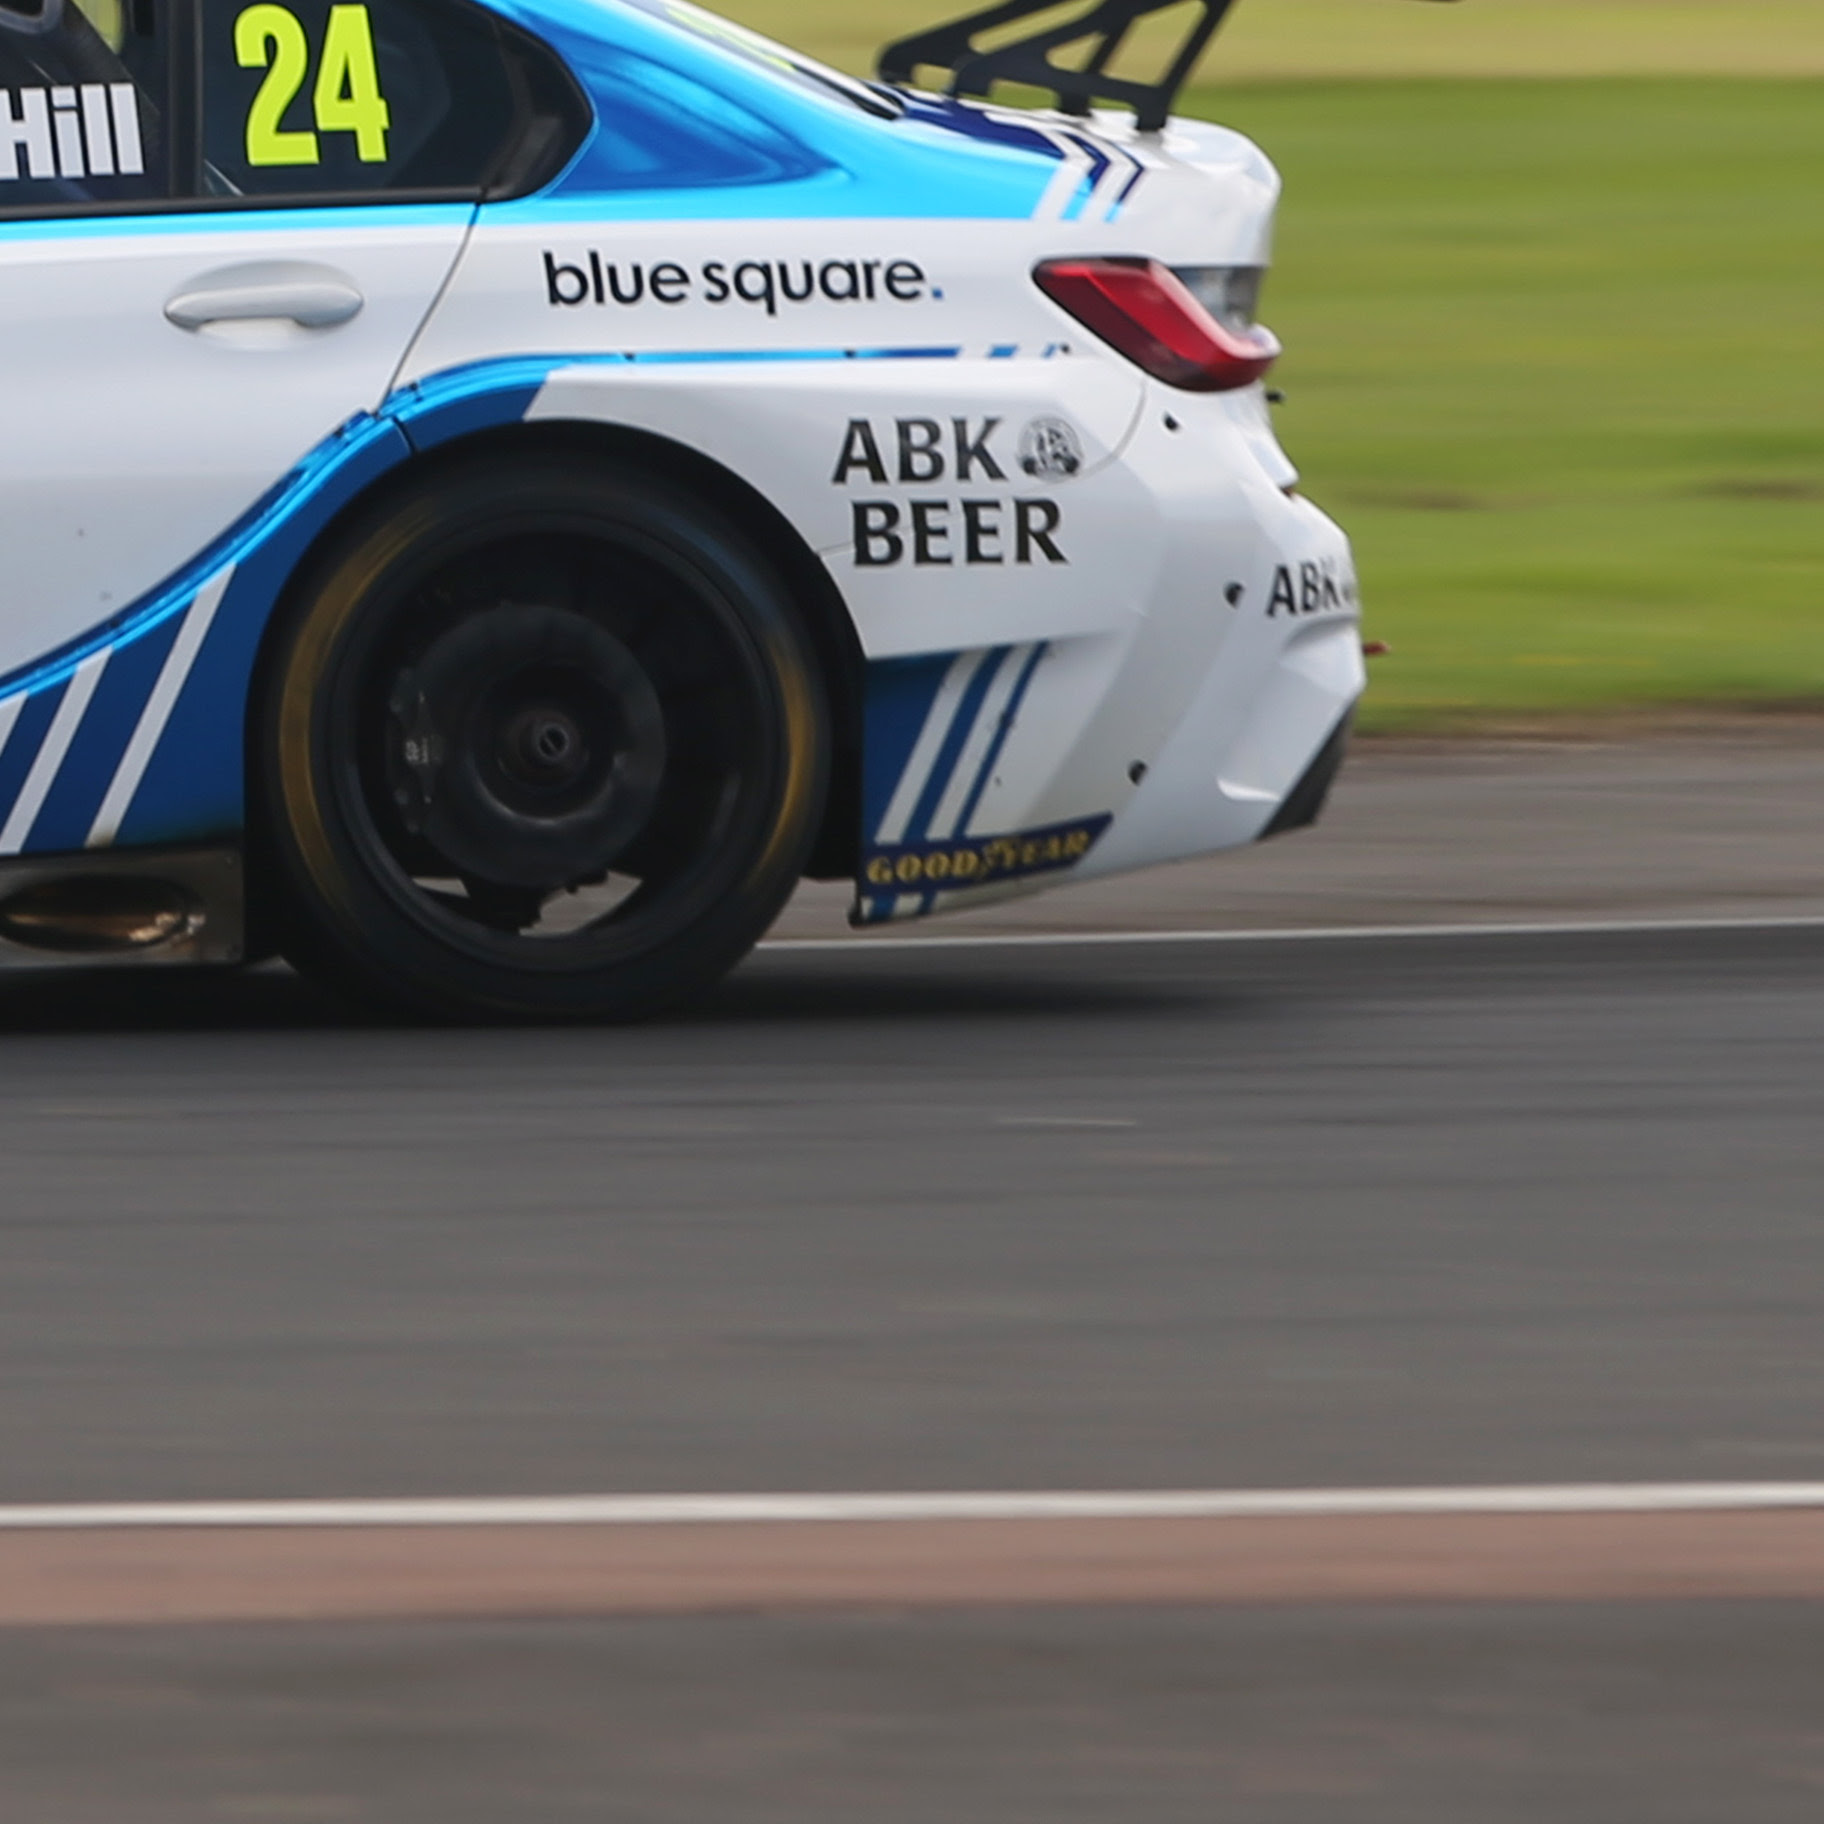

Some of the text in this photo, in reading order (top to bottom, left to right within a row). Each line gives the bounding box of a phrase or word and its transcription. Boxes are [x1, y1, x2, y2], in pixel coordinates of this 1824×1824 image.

[232, 2, 390, 167] 24
[543, 251, 944, 316] blue square.
[832, 416, 1008, 486] ABK
[851, 497, 1068, 567] BEER
